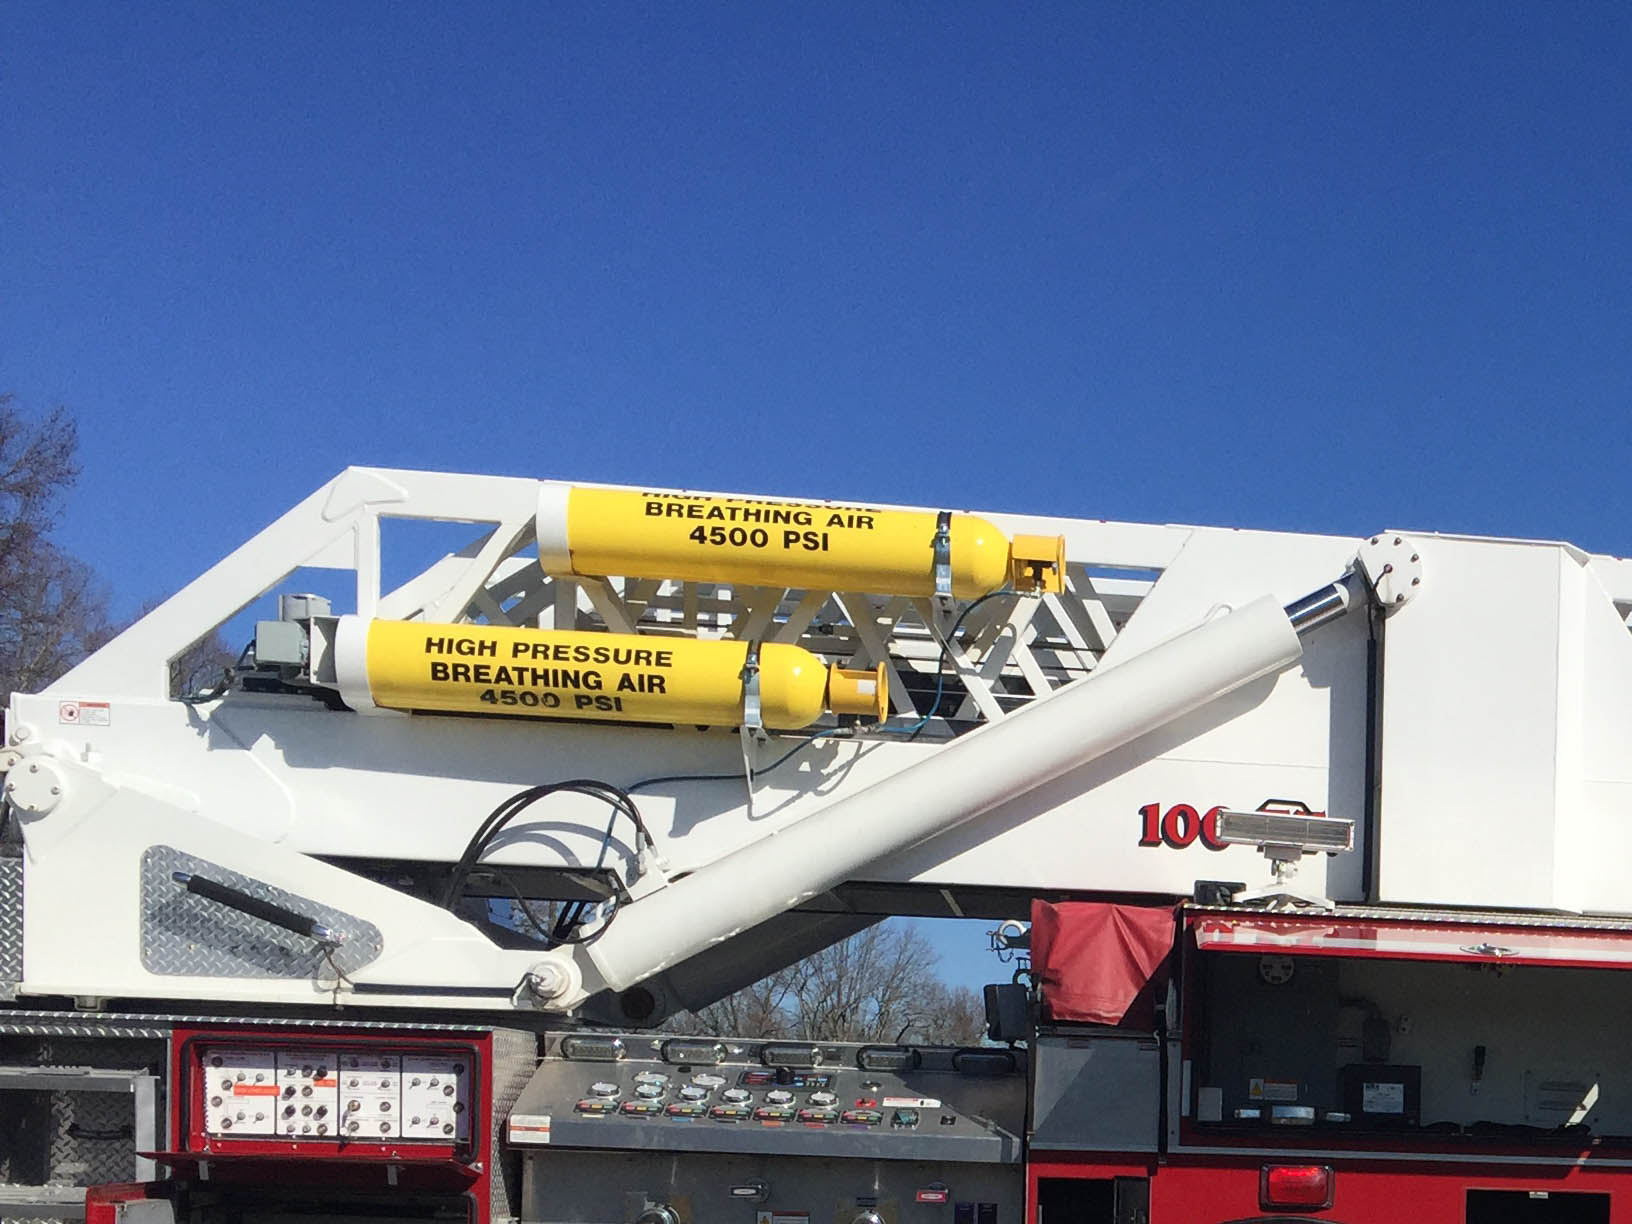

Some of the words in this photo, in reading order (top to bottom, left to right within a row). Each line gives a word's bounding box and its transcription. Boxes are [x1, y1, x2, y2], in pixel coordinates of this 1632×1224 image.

[646, 501, 812, 526] BREATHING
[826, 513, 875, 530] AIR
[689, 525, 769, 548] 4500
[783, 530, 829, 552] PSI
[424, 636, 497, 657] HIGH
[511, 641, 673, 668] PRESSURE
[430, 661, 603, 691] BREATHING
[616, 672, 667, 694] AIR
[479, 688, 561, 708] 4500
[574, 694, 623, 712] PSI
